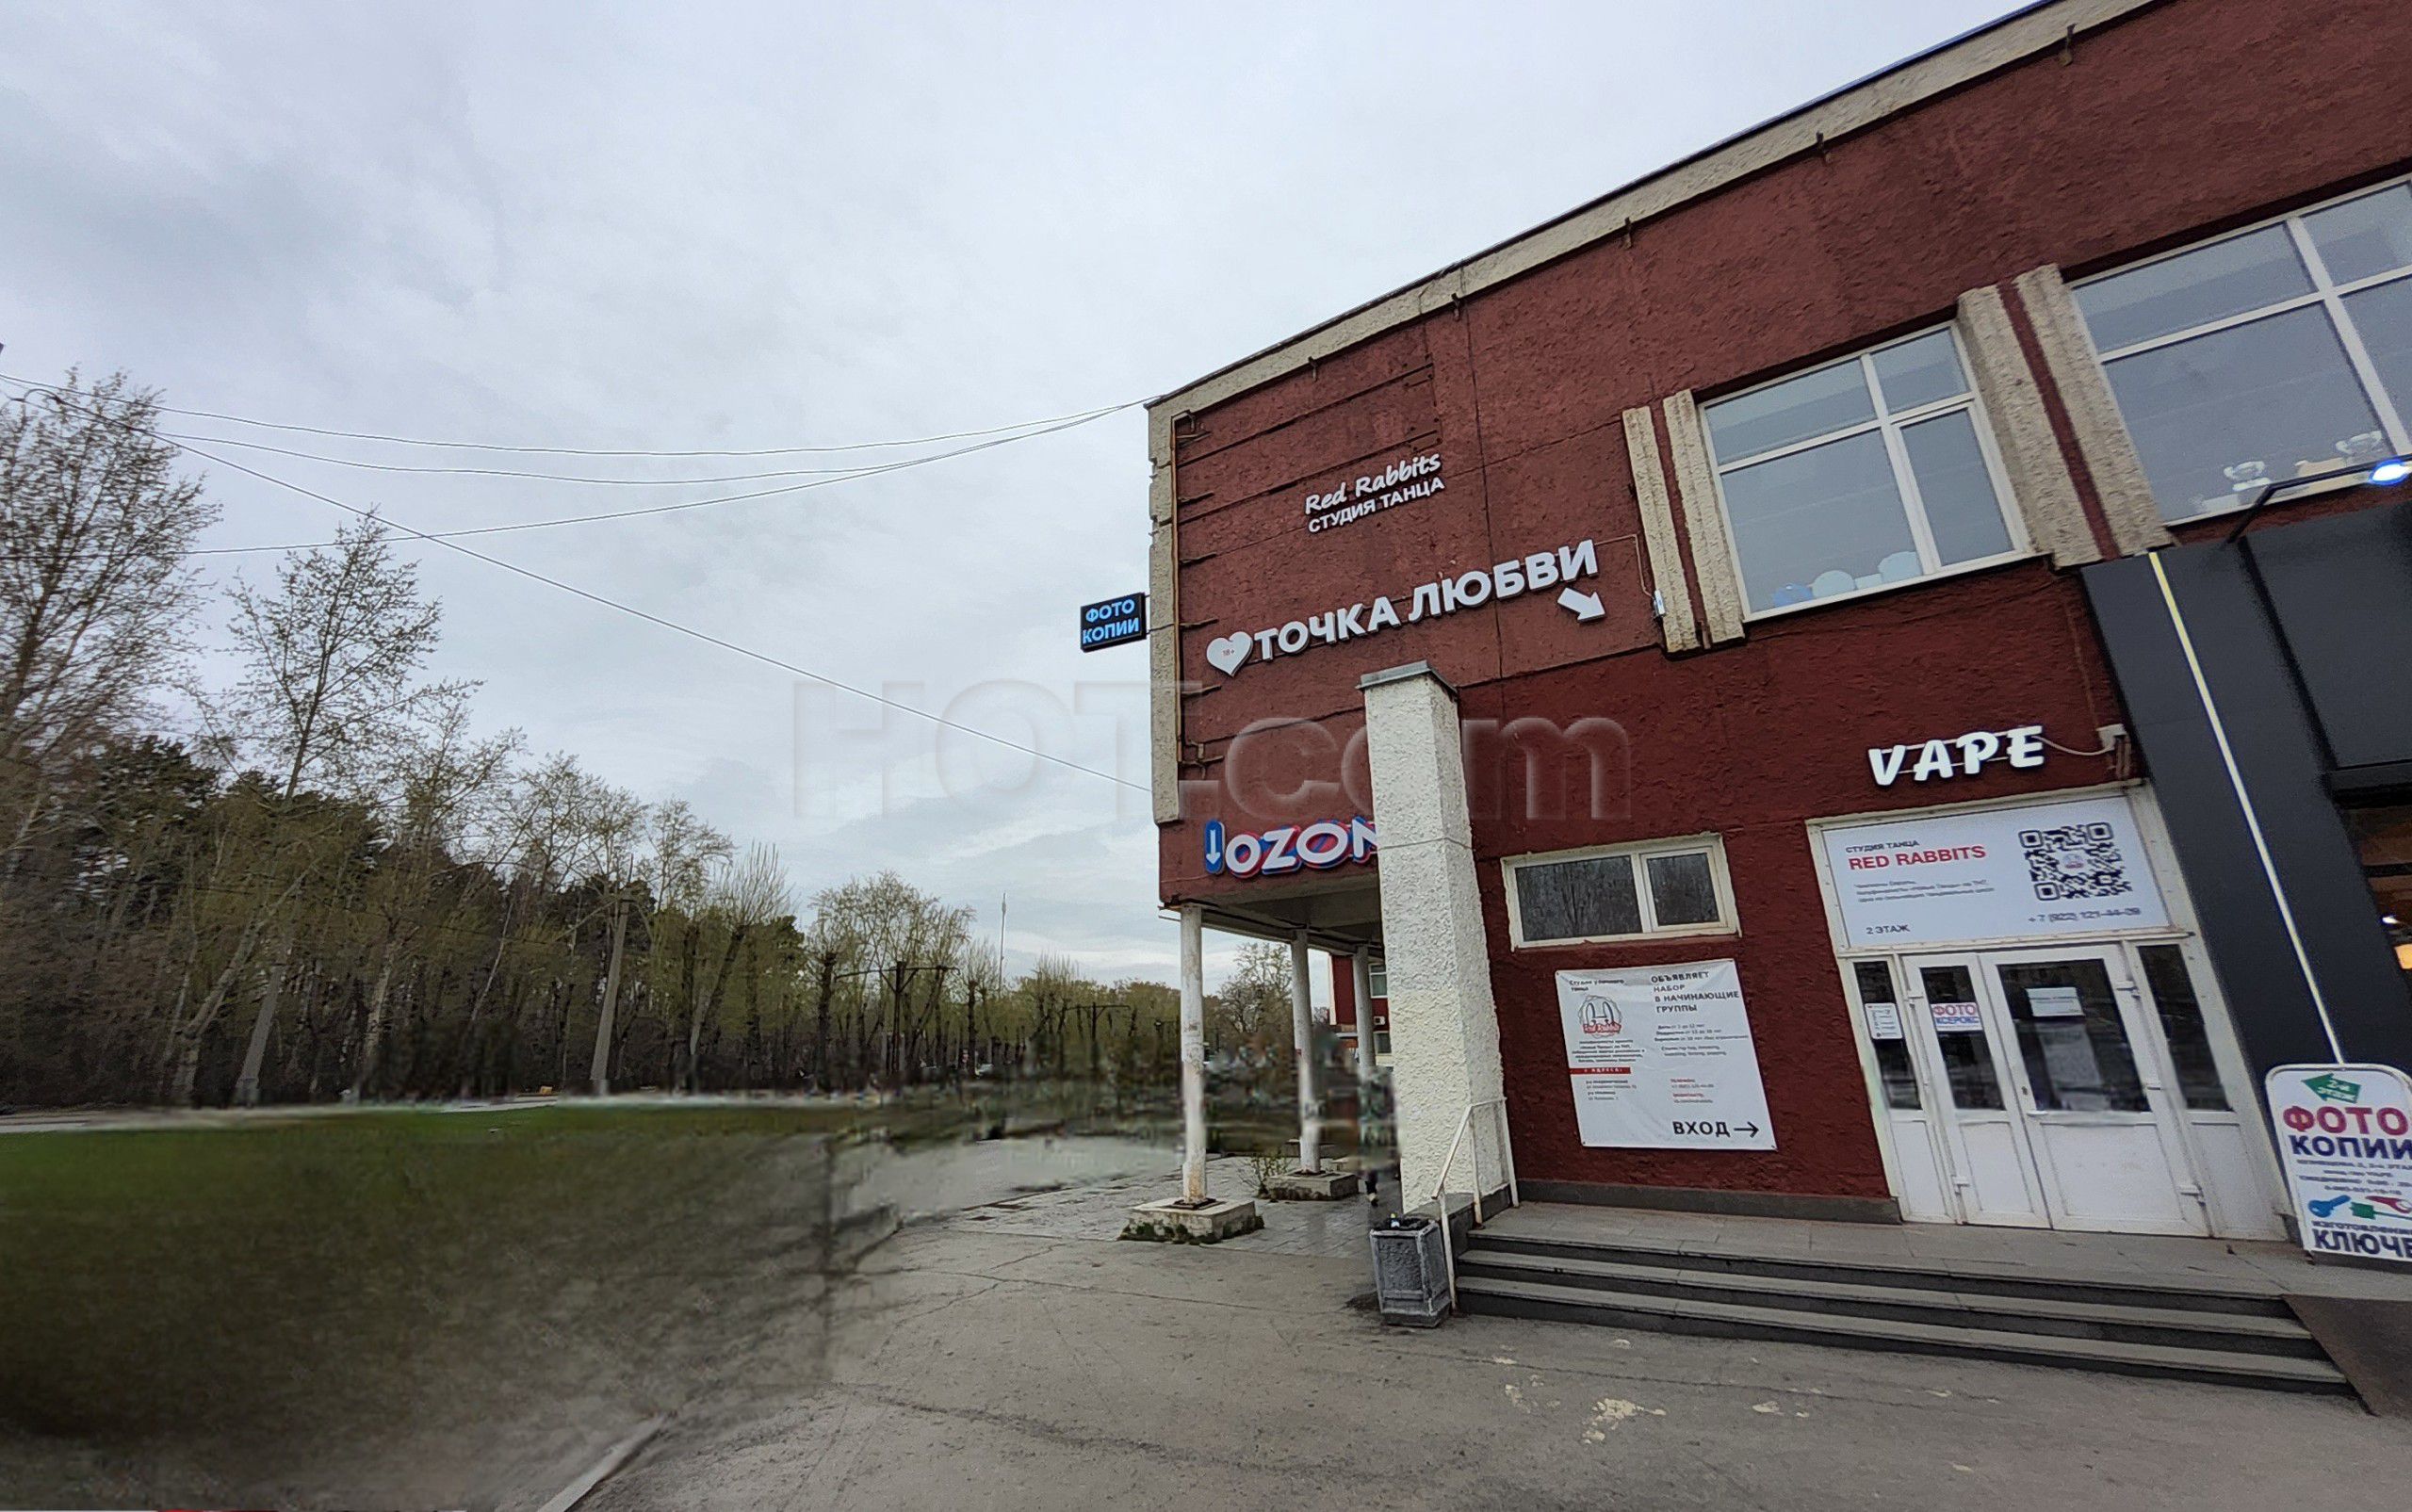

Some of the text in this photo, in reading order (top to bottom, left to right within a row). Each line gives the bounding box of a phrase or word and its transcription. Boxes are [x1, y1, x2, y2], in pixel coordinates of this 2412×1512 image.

[1305, 453, 1442, 514] Red Rabbits
[1309, 477, 1445, 533] СТУДИЯ ТАНЦА
[1085, 598, 1135, 623] ФОТО
[1253, 539, 1599, 661] ТОЧКА ЛЮБВИ
[1082, 617, 1140, 644] КОПИИ
[1867, 724, 2045, 787] VAPE
[1845, 839, 1920, 854] СТУДИЯ ТАНЦА
[1848, 845, 1987, 870] RED RABBITS
[1866, 924, 1911, 935] 2 ЭТАЖ
[1651, 971, 1710, 984] ОБЪЯВЛЯЕТ
[1654, 984, 1686, 993] НАБОР
[1664, 991, 1740, 1001] НАЧИНАЮЩИЕ
[1656, 1004, 1698, 1014] ГРУППЫ
[1933, 1004, 1977, 1016] ФОТО
[1672, 1121, 1731, 1138] ВХОД
[2283, 1105, 2409, 1136] ФОТО
[2289, 1134, 2412, 1160] КОПИИ
